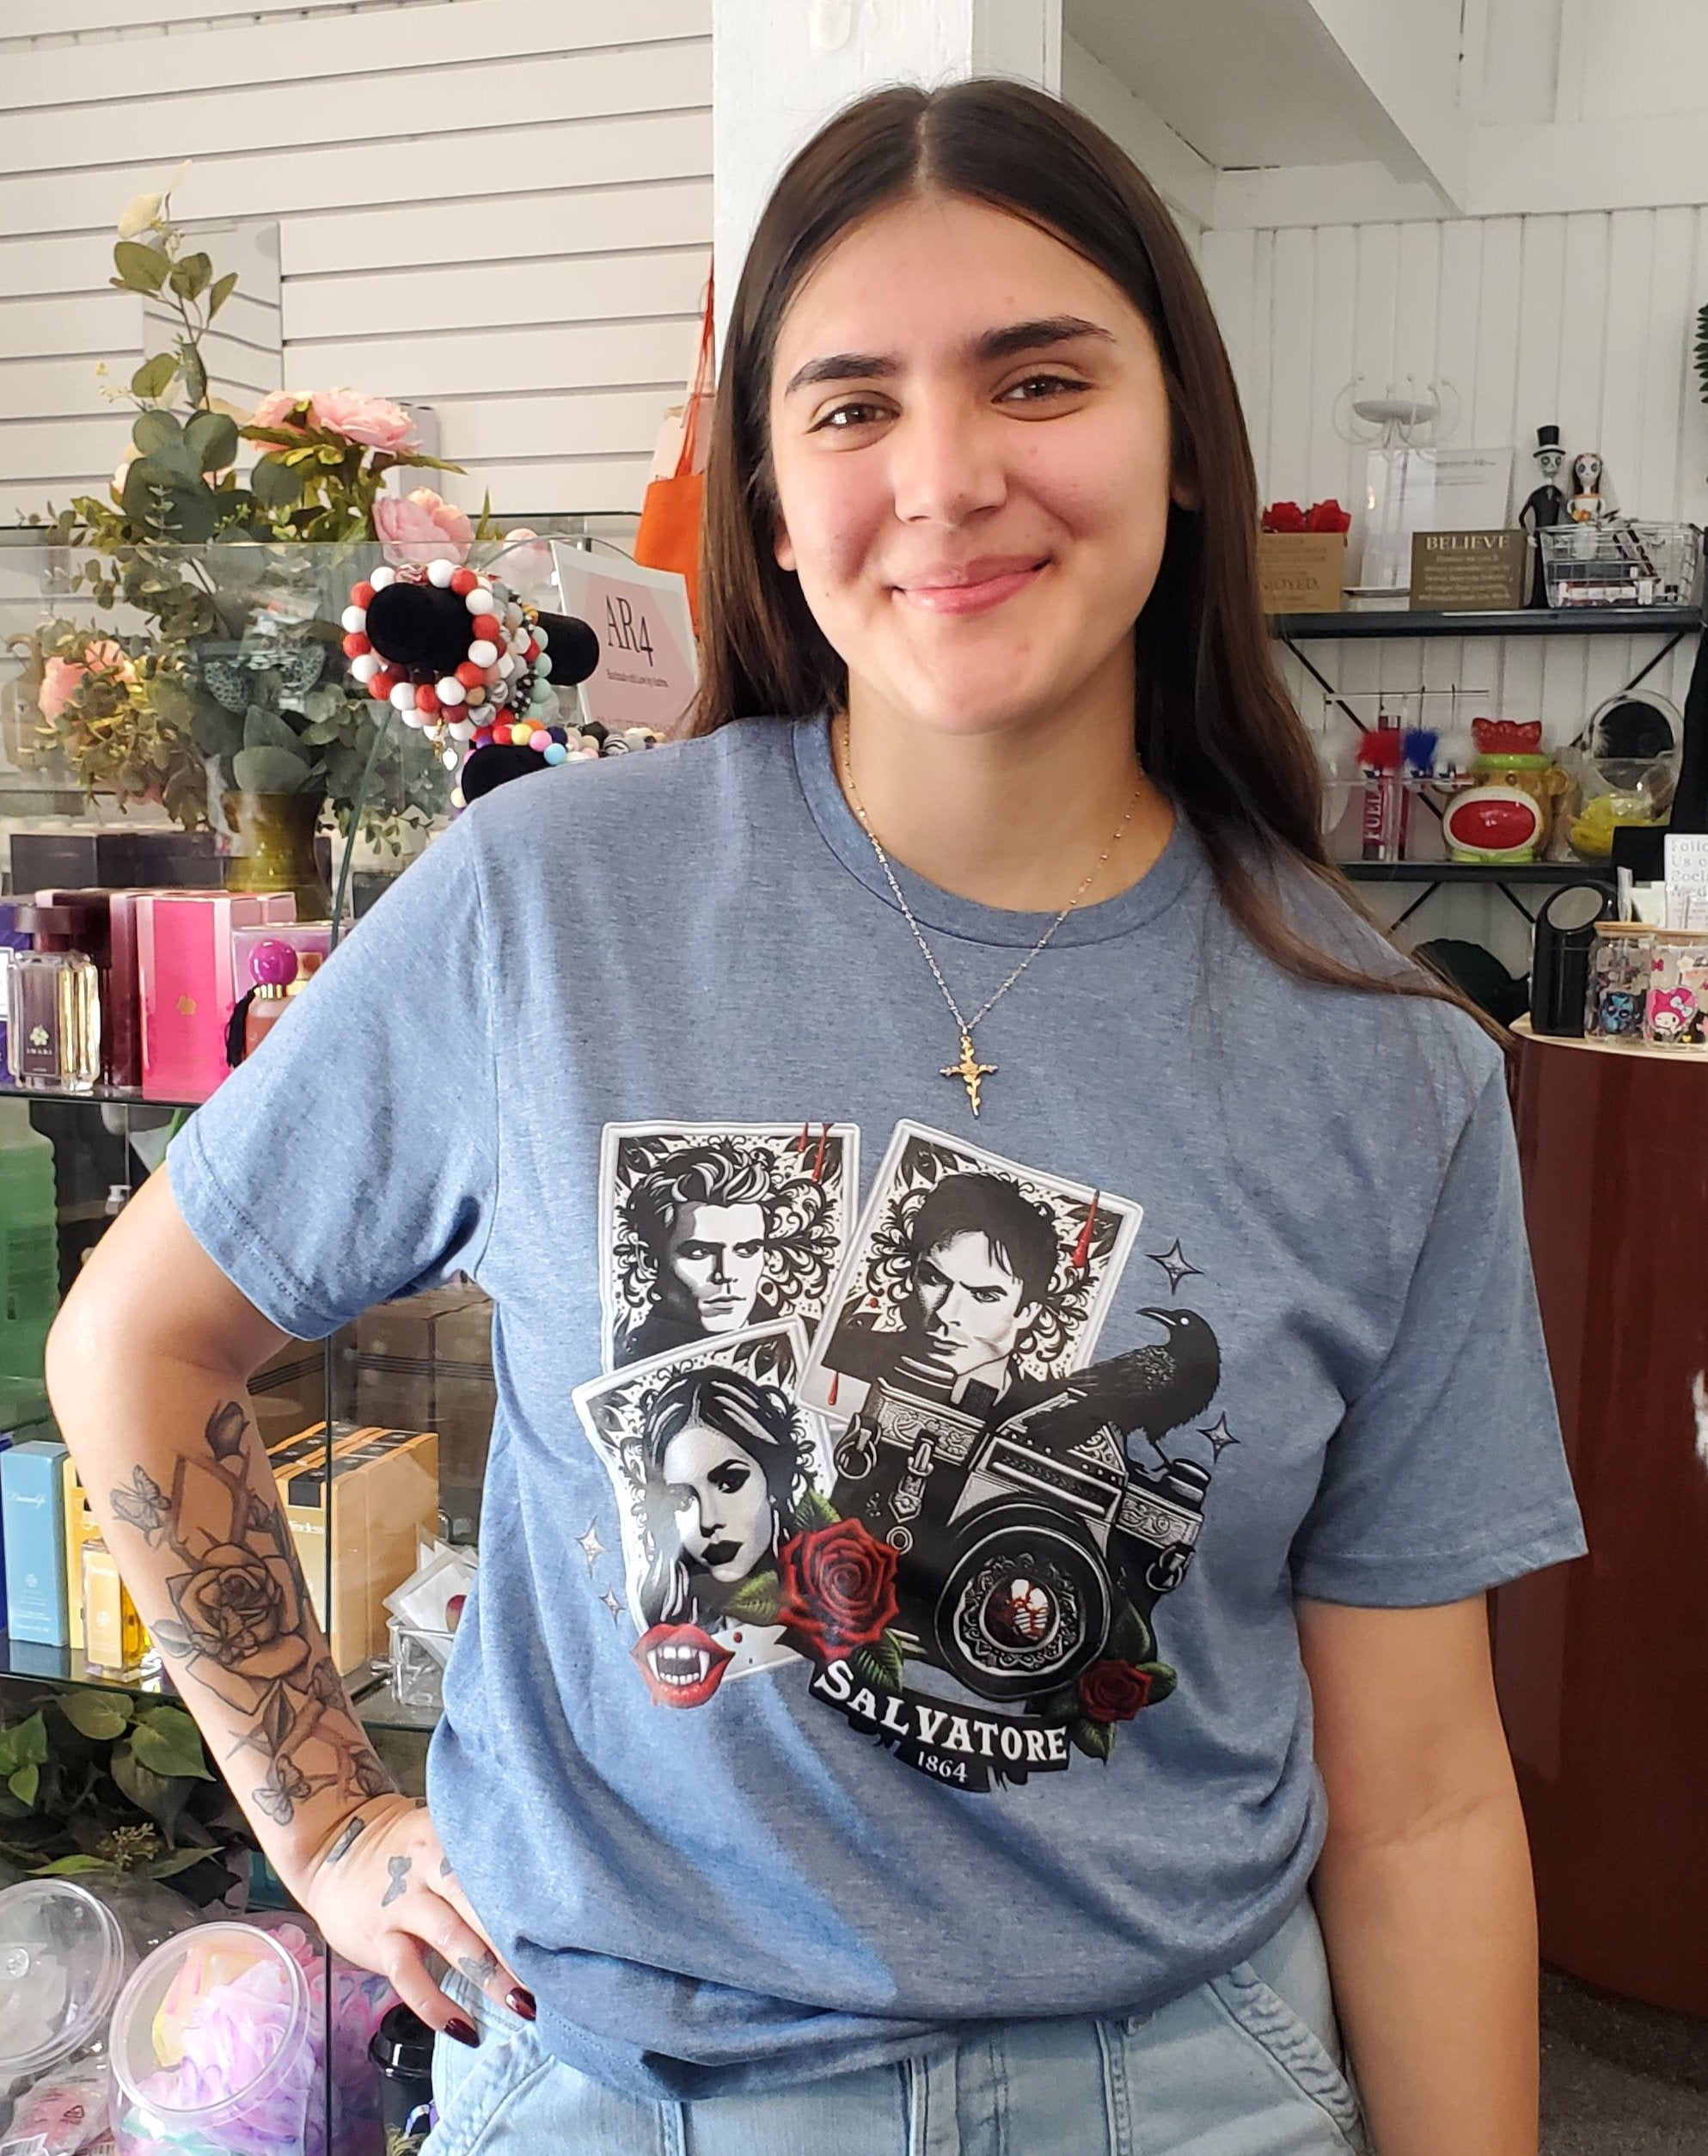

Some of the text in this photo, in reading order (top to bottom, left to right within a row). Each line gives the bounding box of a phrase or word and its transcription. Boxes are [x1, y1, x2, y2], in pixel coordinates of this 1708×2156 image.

[1425, 535, 1511, 550] BELIEVE
[813, 1659, 1067, 1761] SALVATORE
[917, 1750, 968, 1783] 1864
